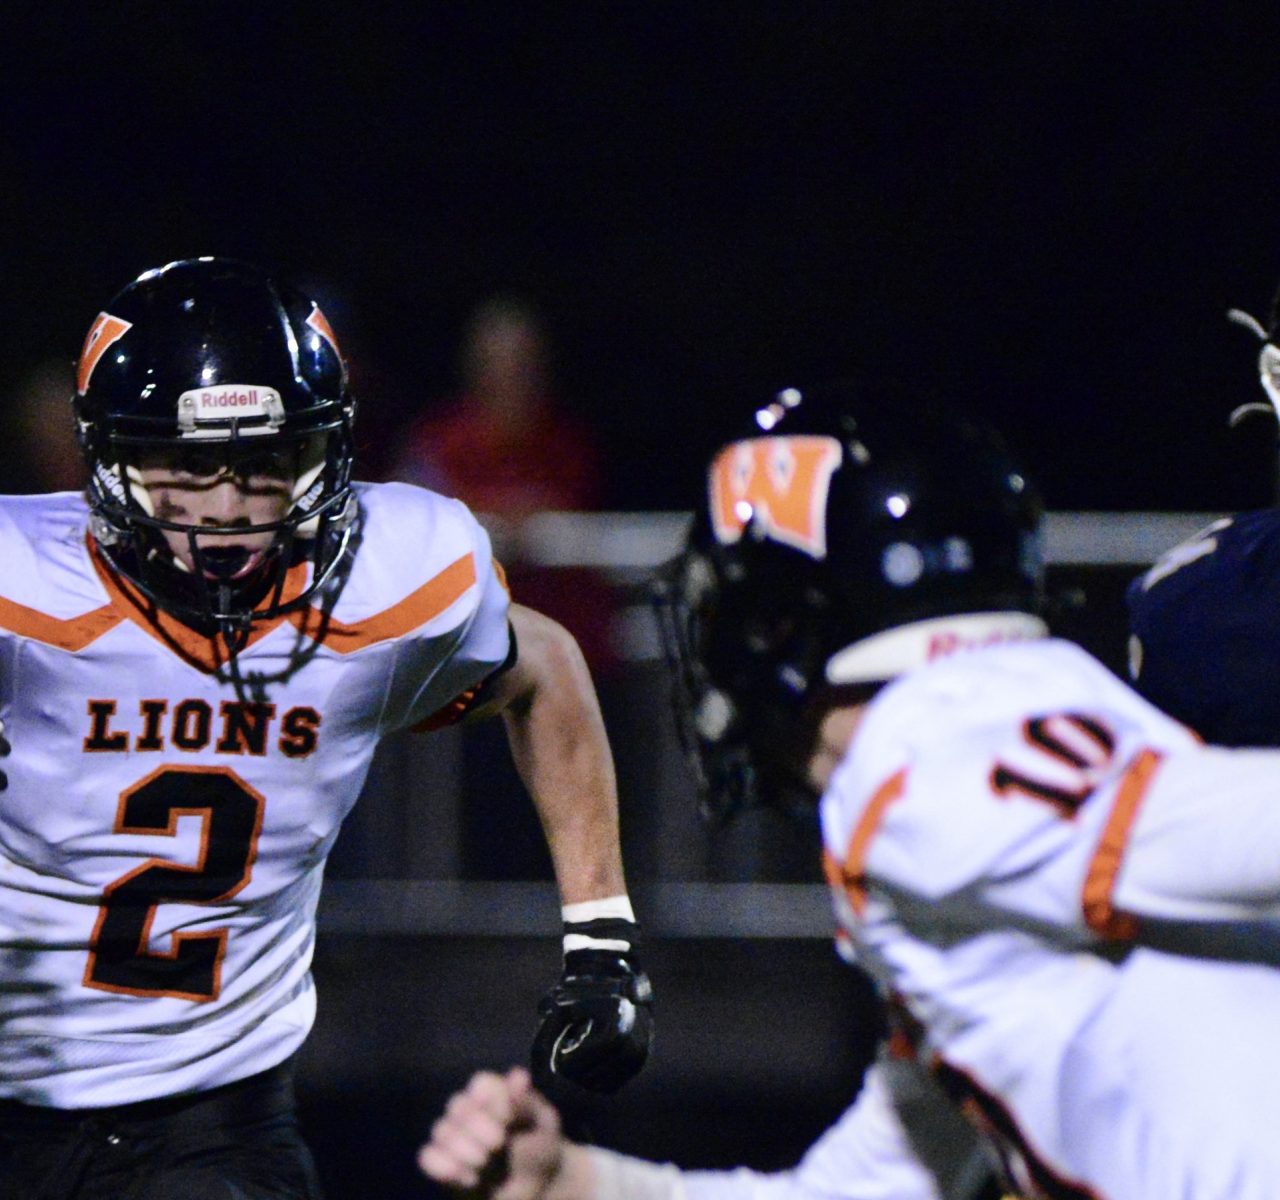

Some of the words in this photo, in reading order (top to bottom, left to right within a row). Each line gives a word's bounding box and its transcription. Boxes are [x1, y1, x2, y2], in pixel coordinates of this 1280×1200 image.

[201, 390, 258, 408] Riddell
[82, 699, 320, 759] LIONS
[990, 710, 1117, 822] 10
[81, 763, 266, 1004] 2
